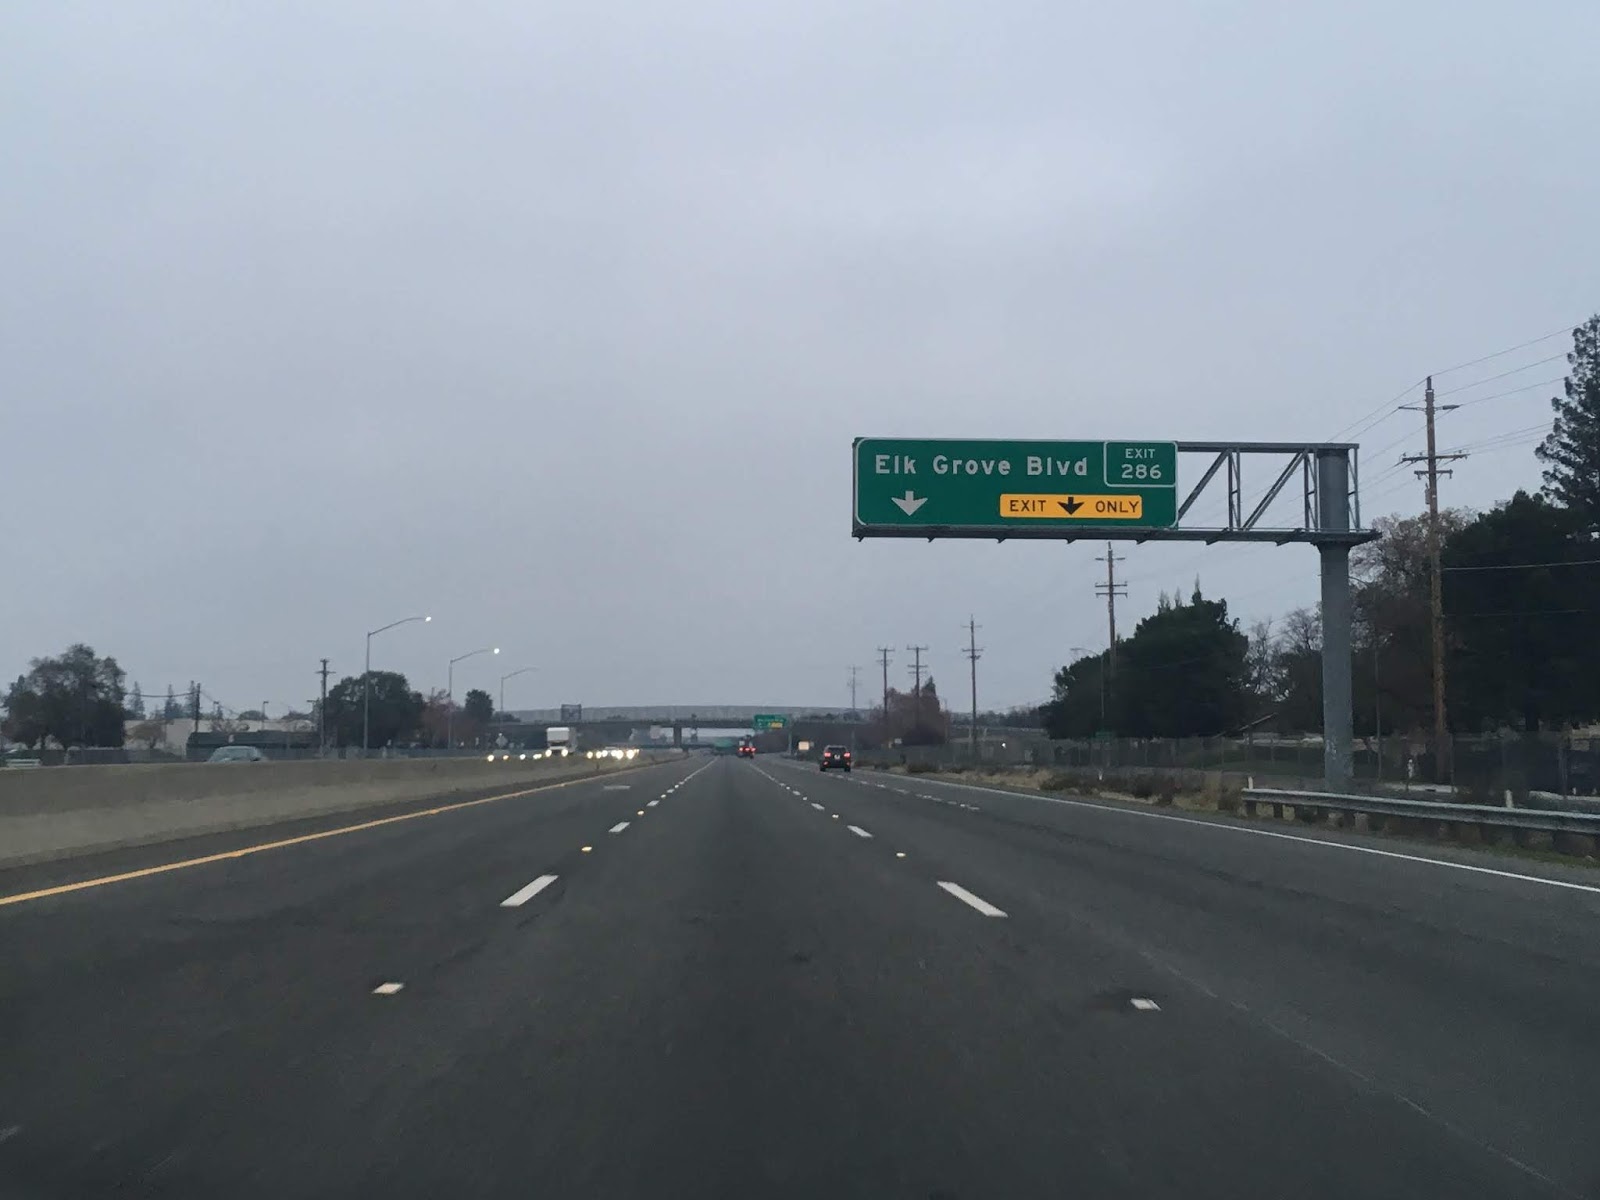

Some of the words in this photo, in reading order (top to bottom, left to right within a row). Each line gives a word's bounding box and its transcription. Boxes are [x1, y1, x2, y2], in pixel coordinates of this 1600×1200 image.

[1125, 448, 1156, 459] EXIT
[875, 455, 917, 475] Elk
[932, 455, 1011, 476] Grove
[1026, 456, 1088, 477] Blvd
[1121, 464, 1162, 480] 286
[1009, 500, 1046, 512] EXIT
[1095, 500, 1139, 513] ONLY
